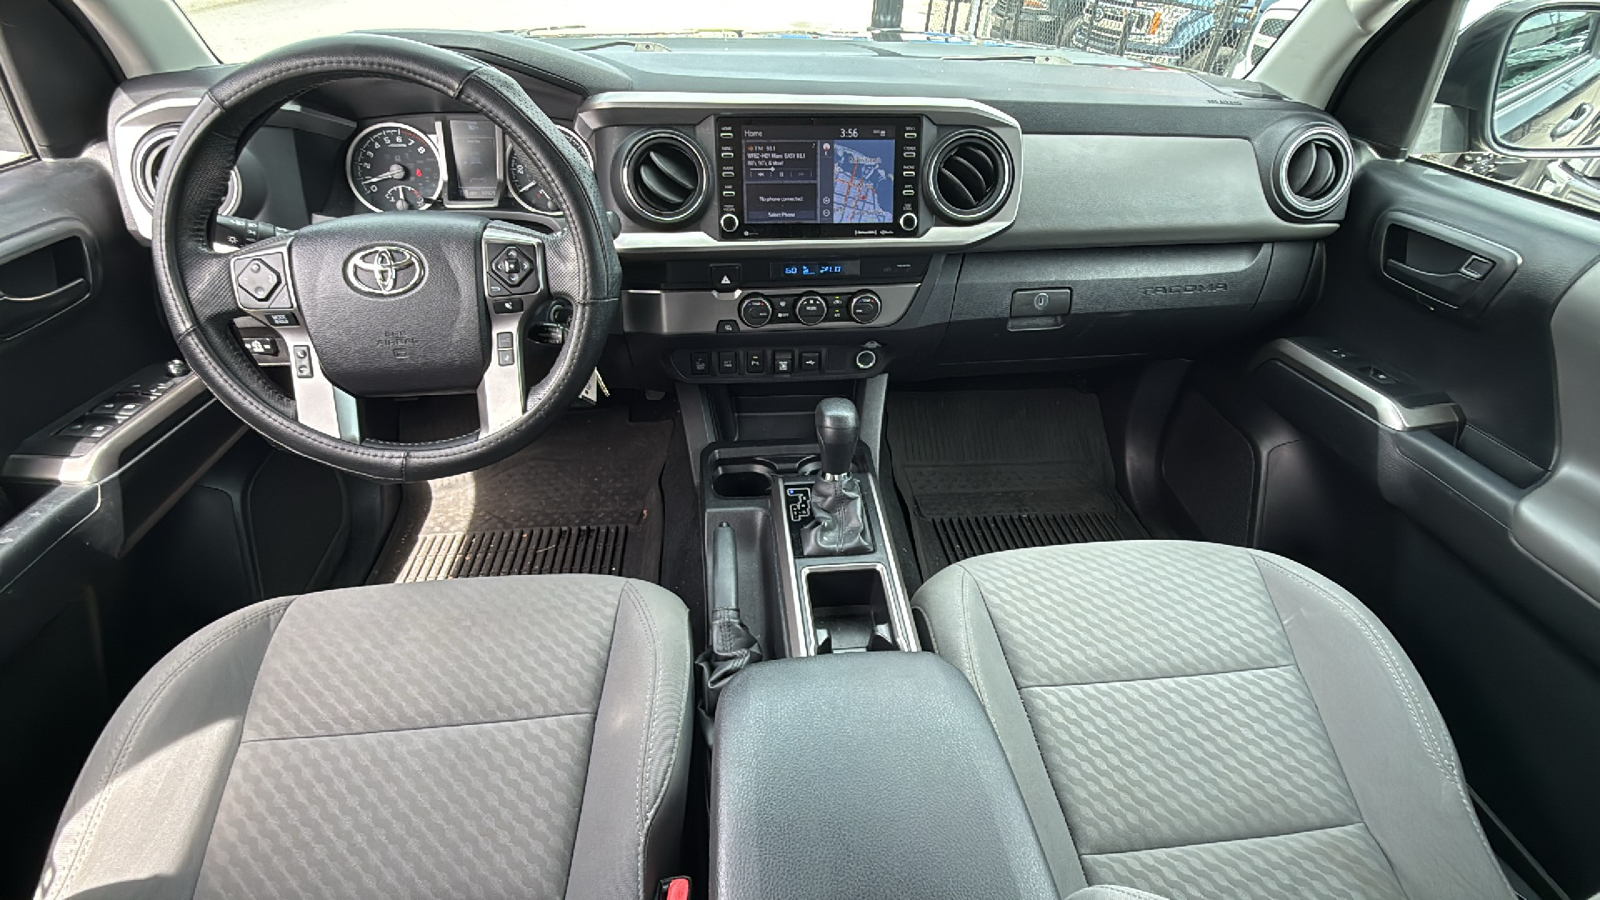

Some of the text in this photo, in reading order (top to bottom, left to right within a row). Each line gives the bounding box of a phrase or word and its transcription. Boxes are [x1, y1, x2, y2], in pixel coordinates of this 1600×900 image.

[744, 129, 763, 138] Home
[839, 128, 859, 138] 3:56
[383, 136, 391, 144] 5
[407, 138, 416, 146] 7
[374, 141, 381, 149] 4
[366, 150, 374, 159] 3
[417, 146, 426, 154] 8
[369, 184, 378, 193] 0
[1139, 282, 1228, 296] TACOMA
